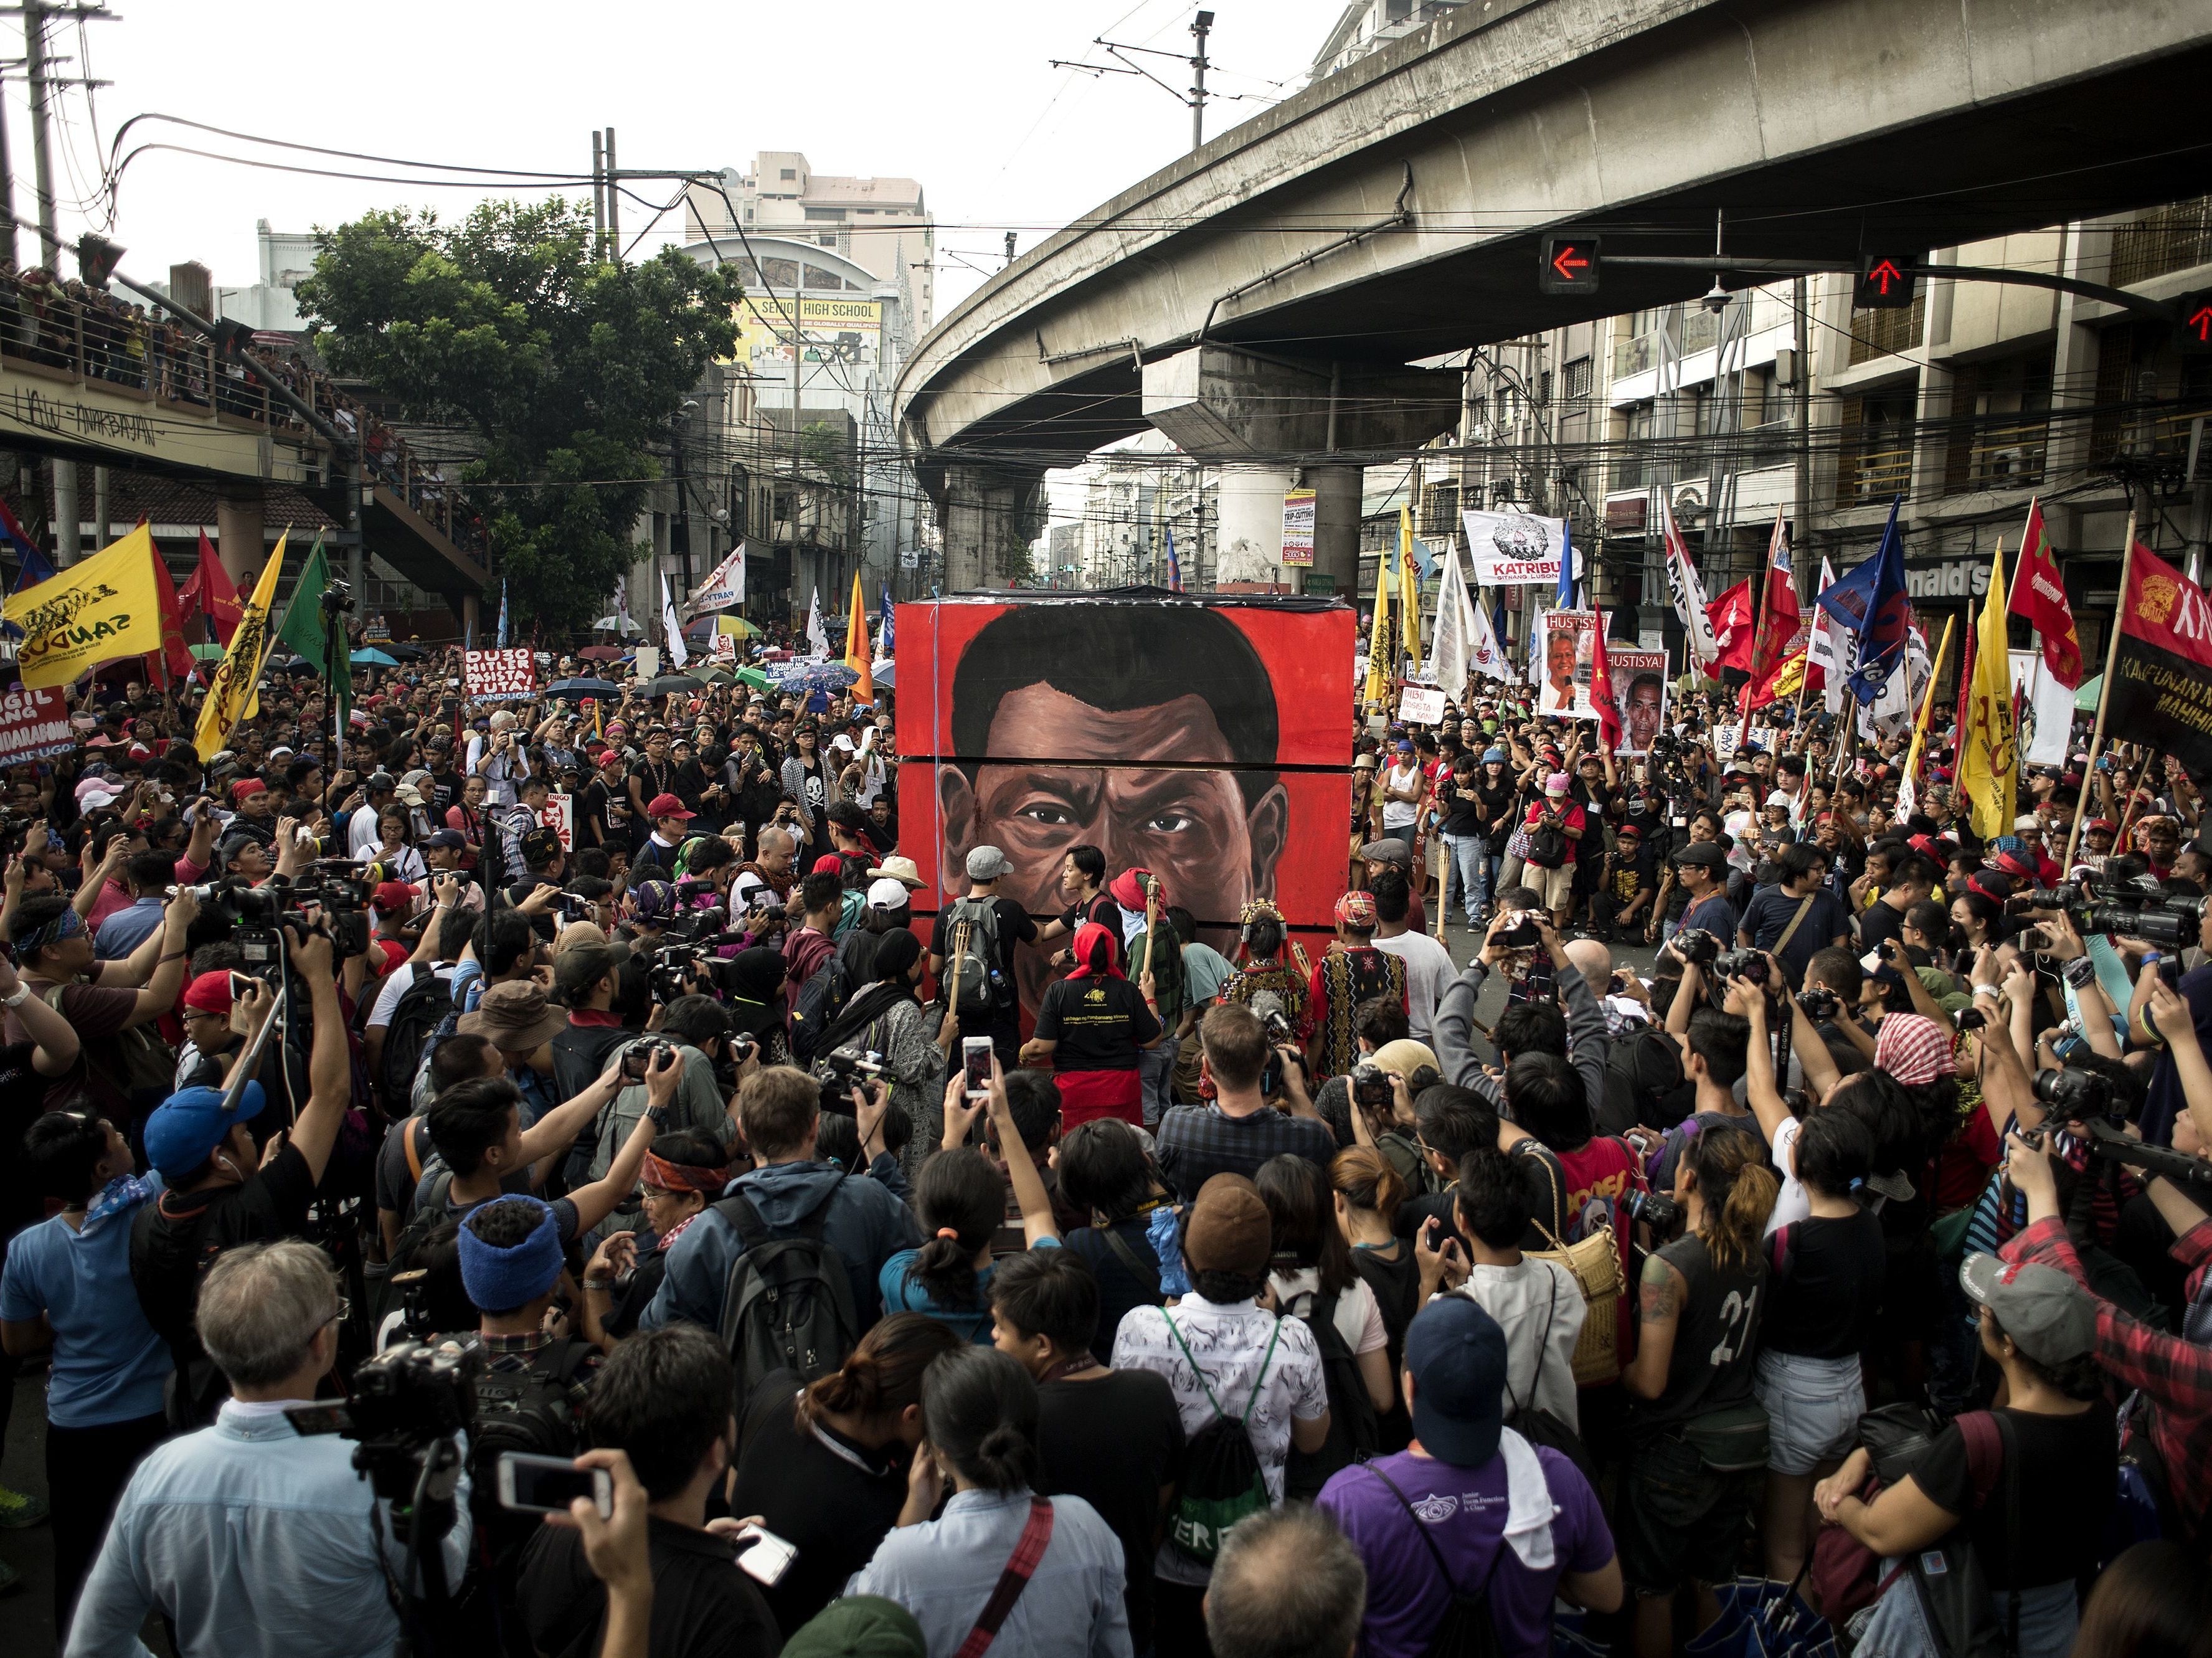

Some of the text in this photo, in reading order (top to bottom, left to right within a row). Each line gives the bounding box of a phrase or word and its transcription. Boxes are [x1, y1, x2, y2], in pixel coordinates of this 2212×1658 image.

[762, 301, 795, 314] SENIO
[804, 303, 829, 316] HIGH
[833, 304, 874, 318] SCHOOL
[1284, 511, 1313, 521] TRIP-CUTTING
[1493, 561, 1561, 576] KATRIBU
[1549, 616, 1606, 630] HUSTISY!
[466, 659, 529, 673] HITLER
[1607, 655, 1663, 668] HUSTISYA!
[466, 670, 527, 684] PASISTA
[467, 675, 532, 694] TUTA!
[0, 743, 77, 767] ANDUGO-
[549, 793, 570, 802] DUGO
[1137, 1199, 1160, 1211] Nikon
[1274, 1250, 1298, 1258] anon
[1709, 1285, 1758, 1366] 21
[1462, 1491, 1480, 1499] Junior
[1479, 1495, 1506, 1504] Function
